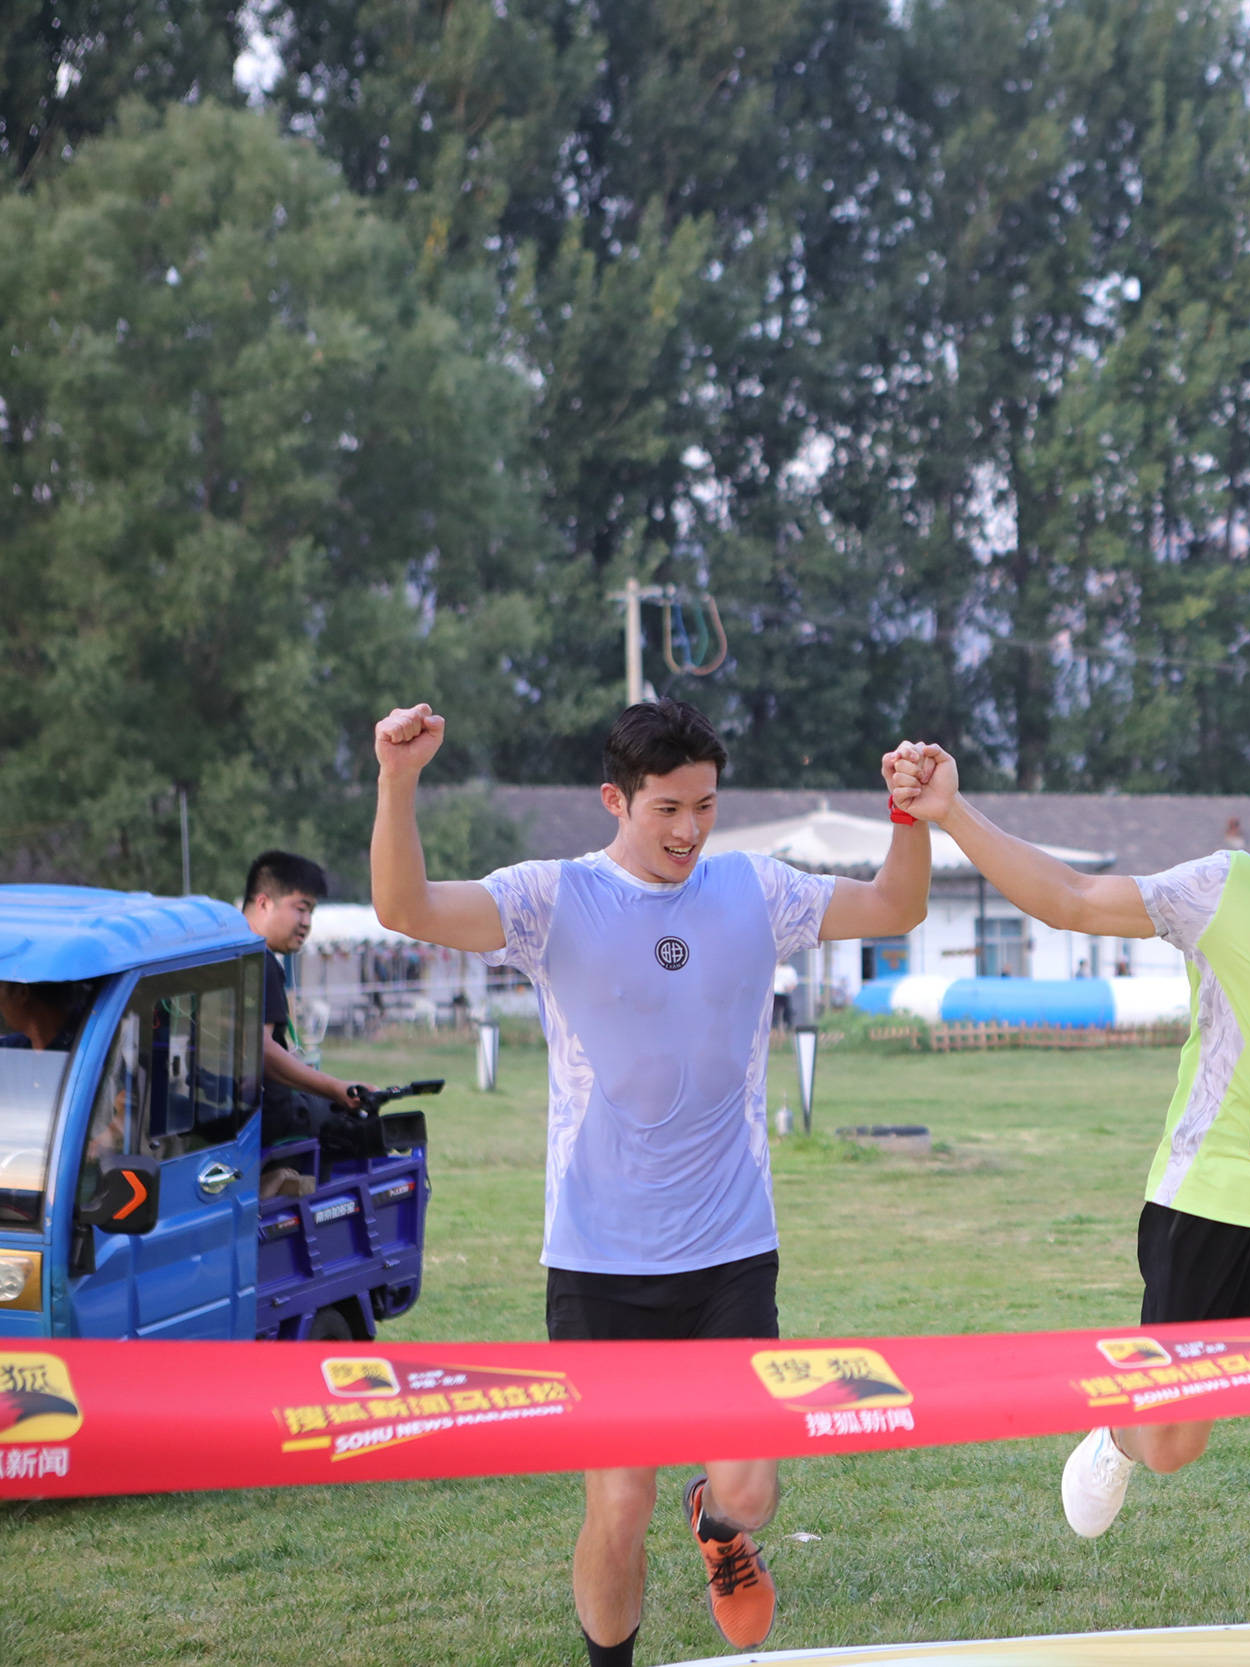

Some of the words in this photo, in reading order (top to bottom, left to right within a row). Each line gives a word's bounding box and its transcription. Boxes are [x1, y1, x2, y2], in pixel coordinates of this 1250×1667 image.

[335, 1426, 393, 1454] SOHU
[396, 1410, 453, 1438] NEWS
[805, 1406, 915, 1437] 搜狐新闻
[0, 1447, 69, 1479] 新闻
